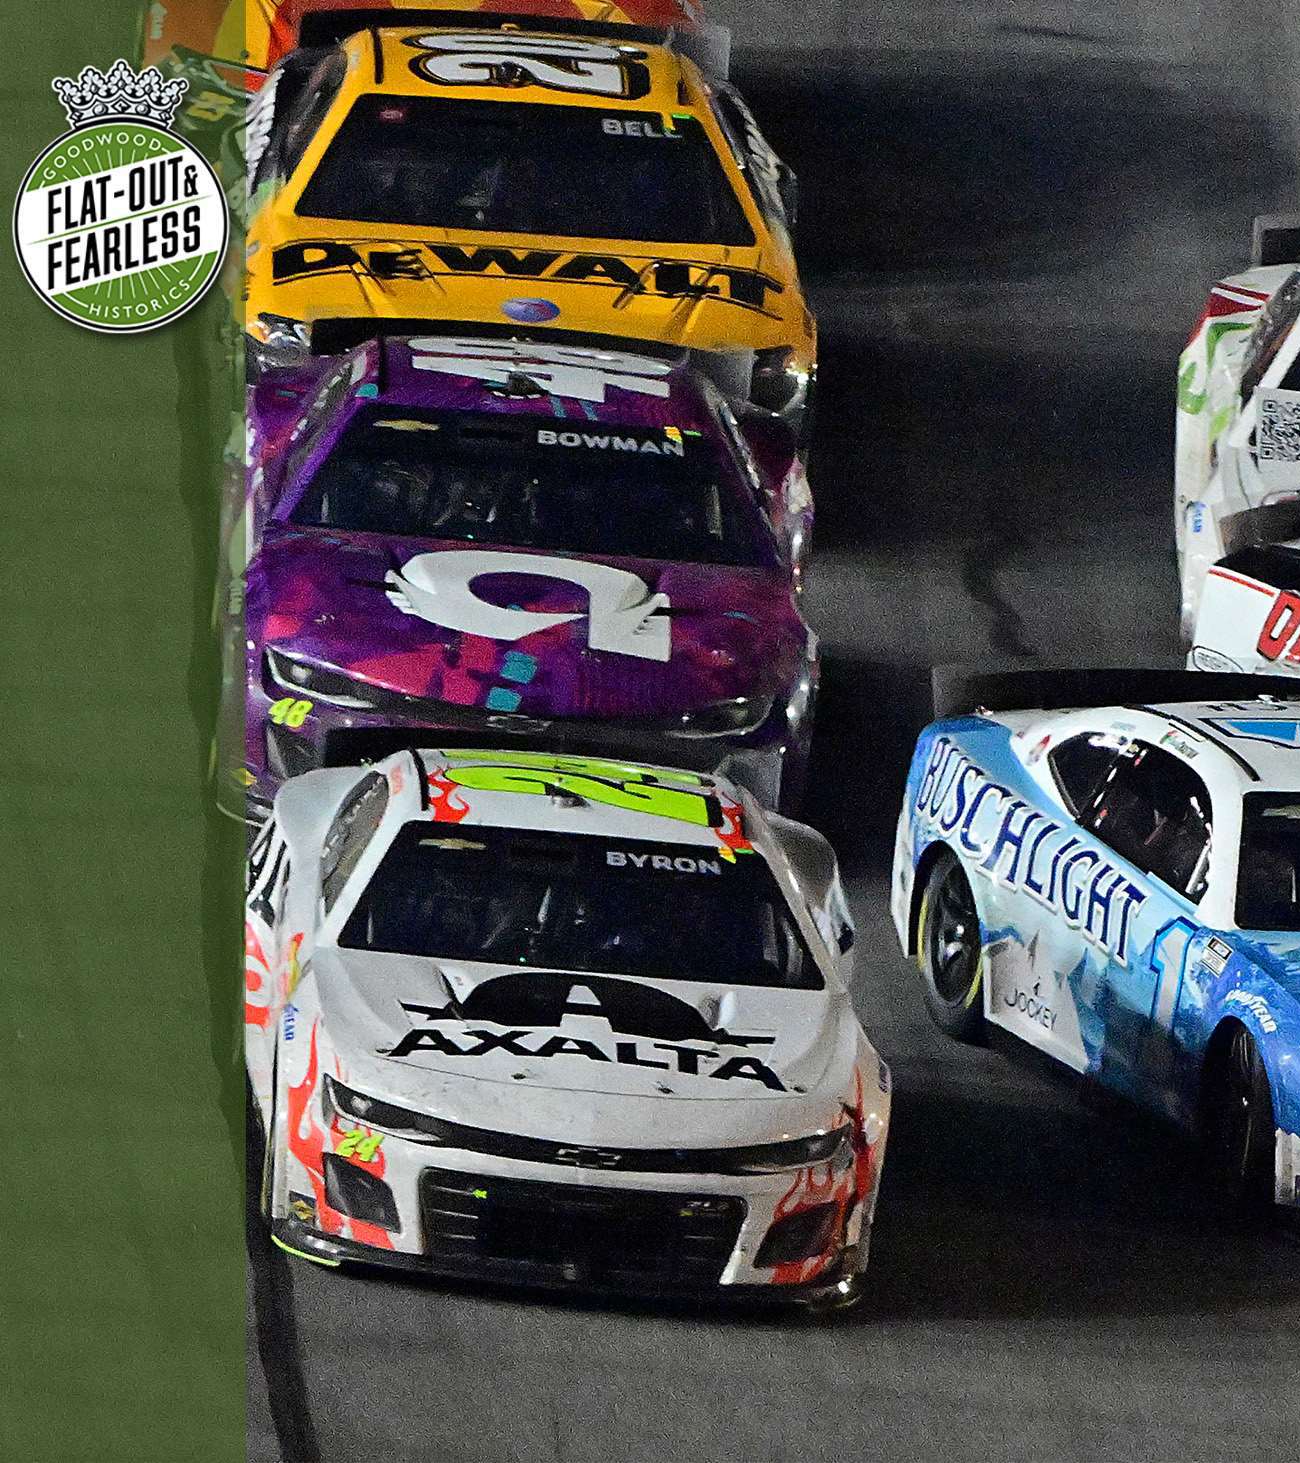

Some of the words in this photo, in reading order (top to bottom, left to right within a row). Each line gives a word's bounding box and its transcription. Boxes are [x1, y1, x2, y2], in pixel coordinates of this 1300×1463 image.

[272, 240, 785, 307] DEWALT
[537, 429, 685, 457] BOWMAN
[267, 697, 314, 728] 48
[606, 851, 721, 875] BYRON
[1004, 987, 1059, 1032] JOCKEY
[386, 1028, 790, 1092] AXALTA
[335, 1128, 385, 1162] 24
